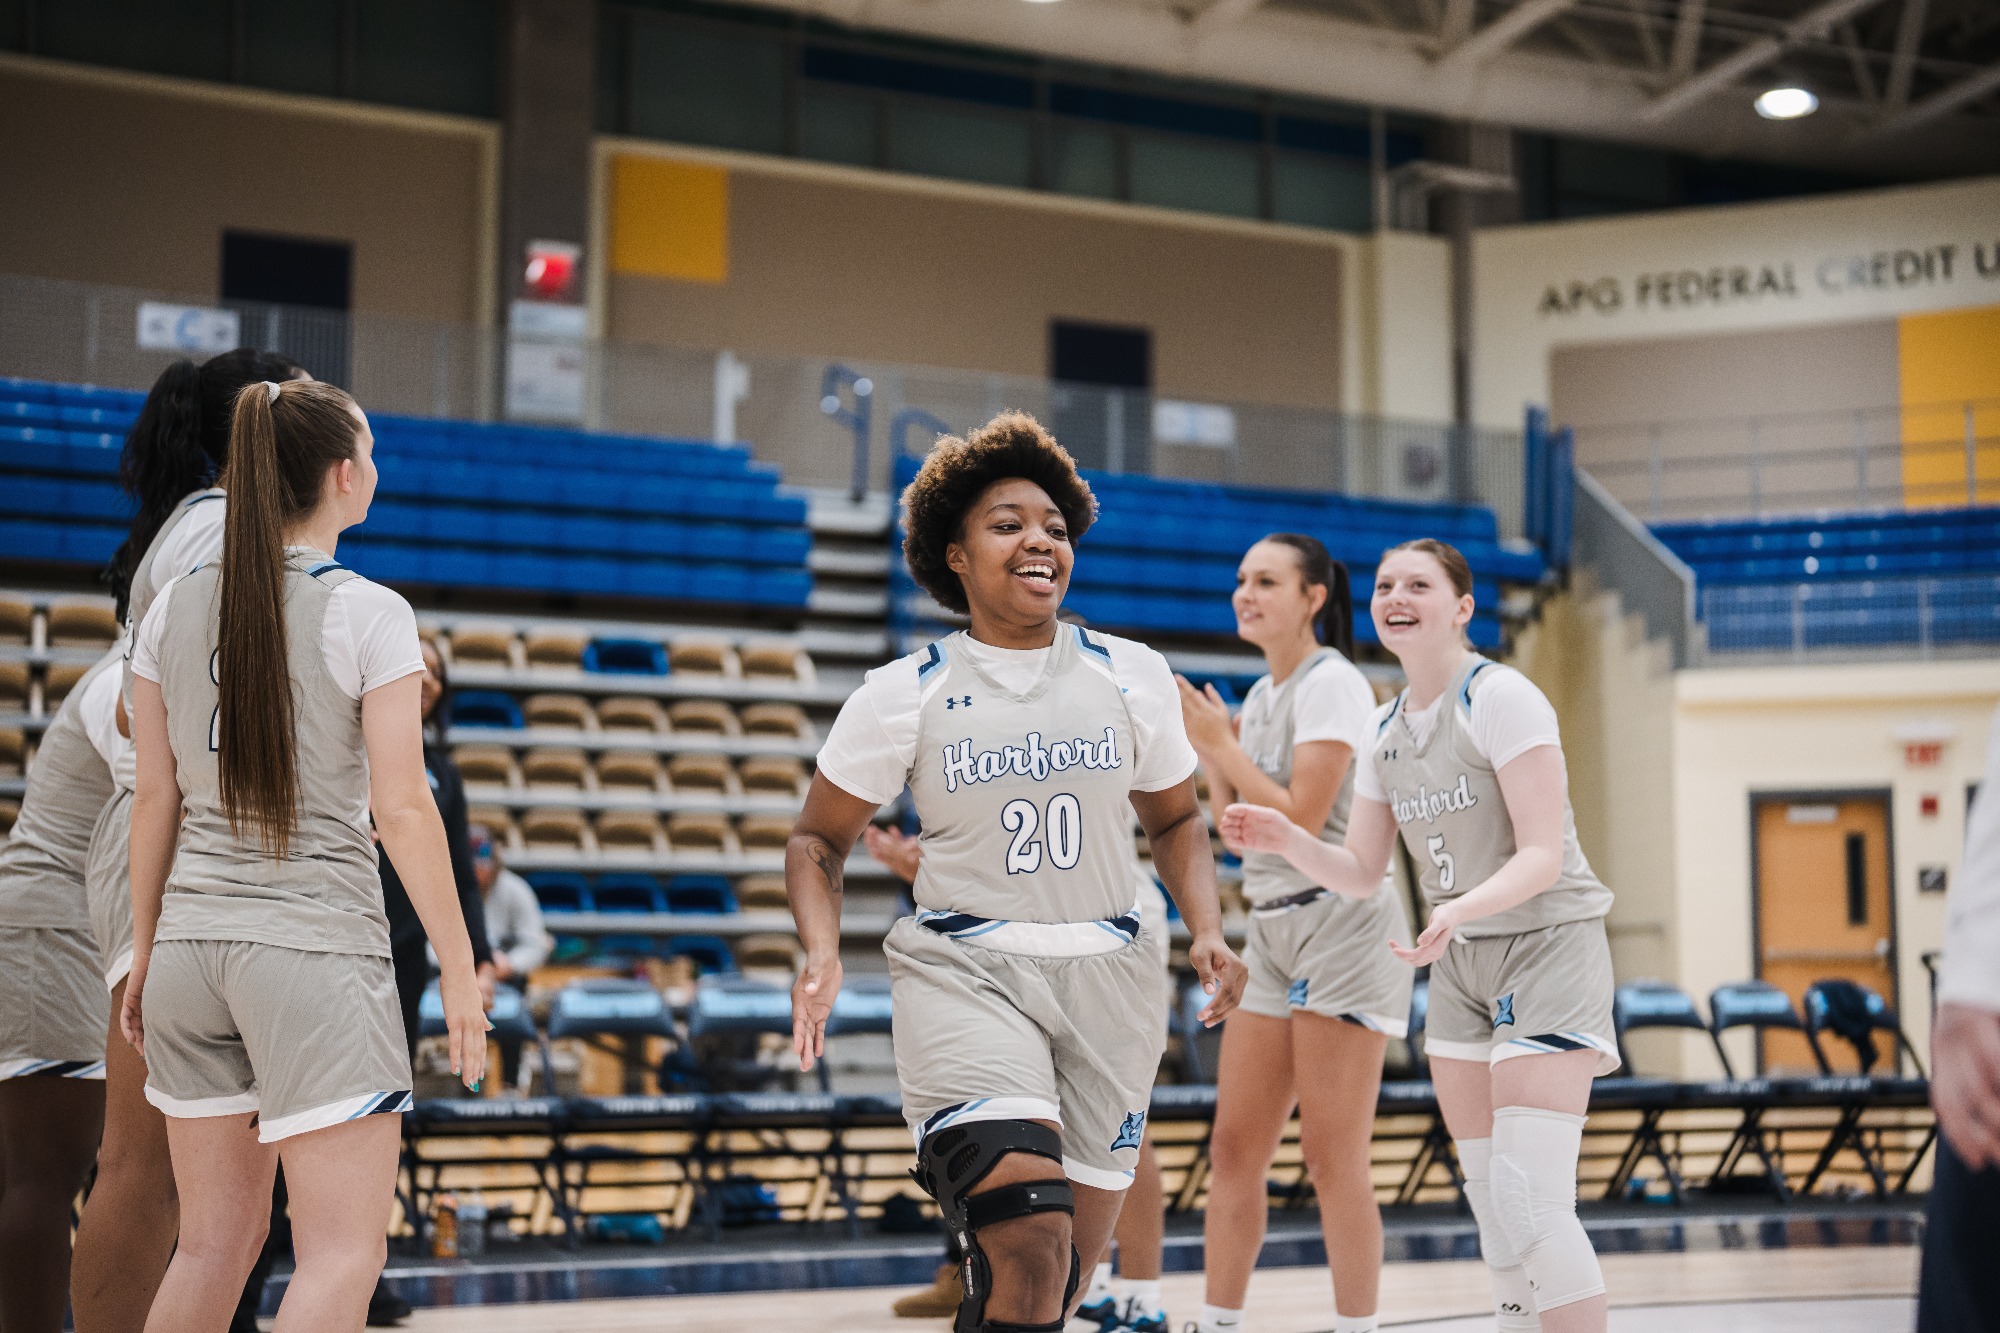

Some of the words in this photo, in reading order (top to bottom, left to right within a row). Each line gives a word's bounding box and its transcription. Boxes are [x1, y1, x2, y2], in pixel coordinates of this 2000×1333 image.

[1538, 277, 1622, 318] APG
[1634, 262, 1797, 311] FEDERAL
[1814, 244, 1957, 292] CREDIT
[943, 727, 1122, 793] Harford
[1001, 793, 1082, 875] 20
[1426, 833, 1456, 892] 5
